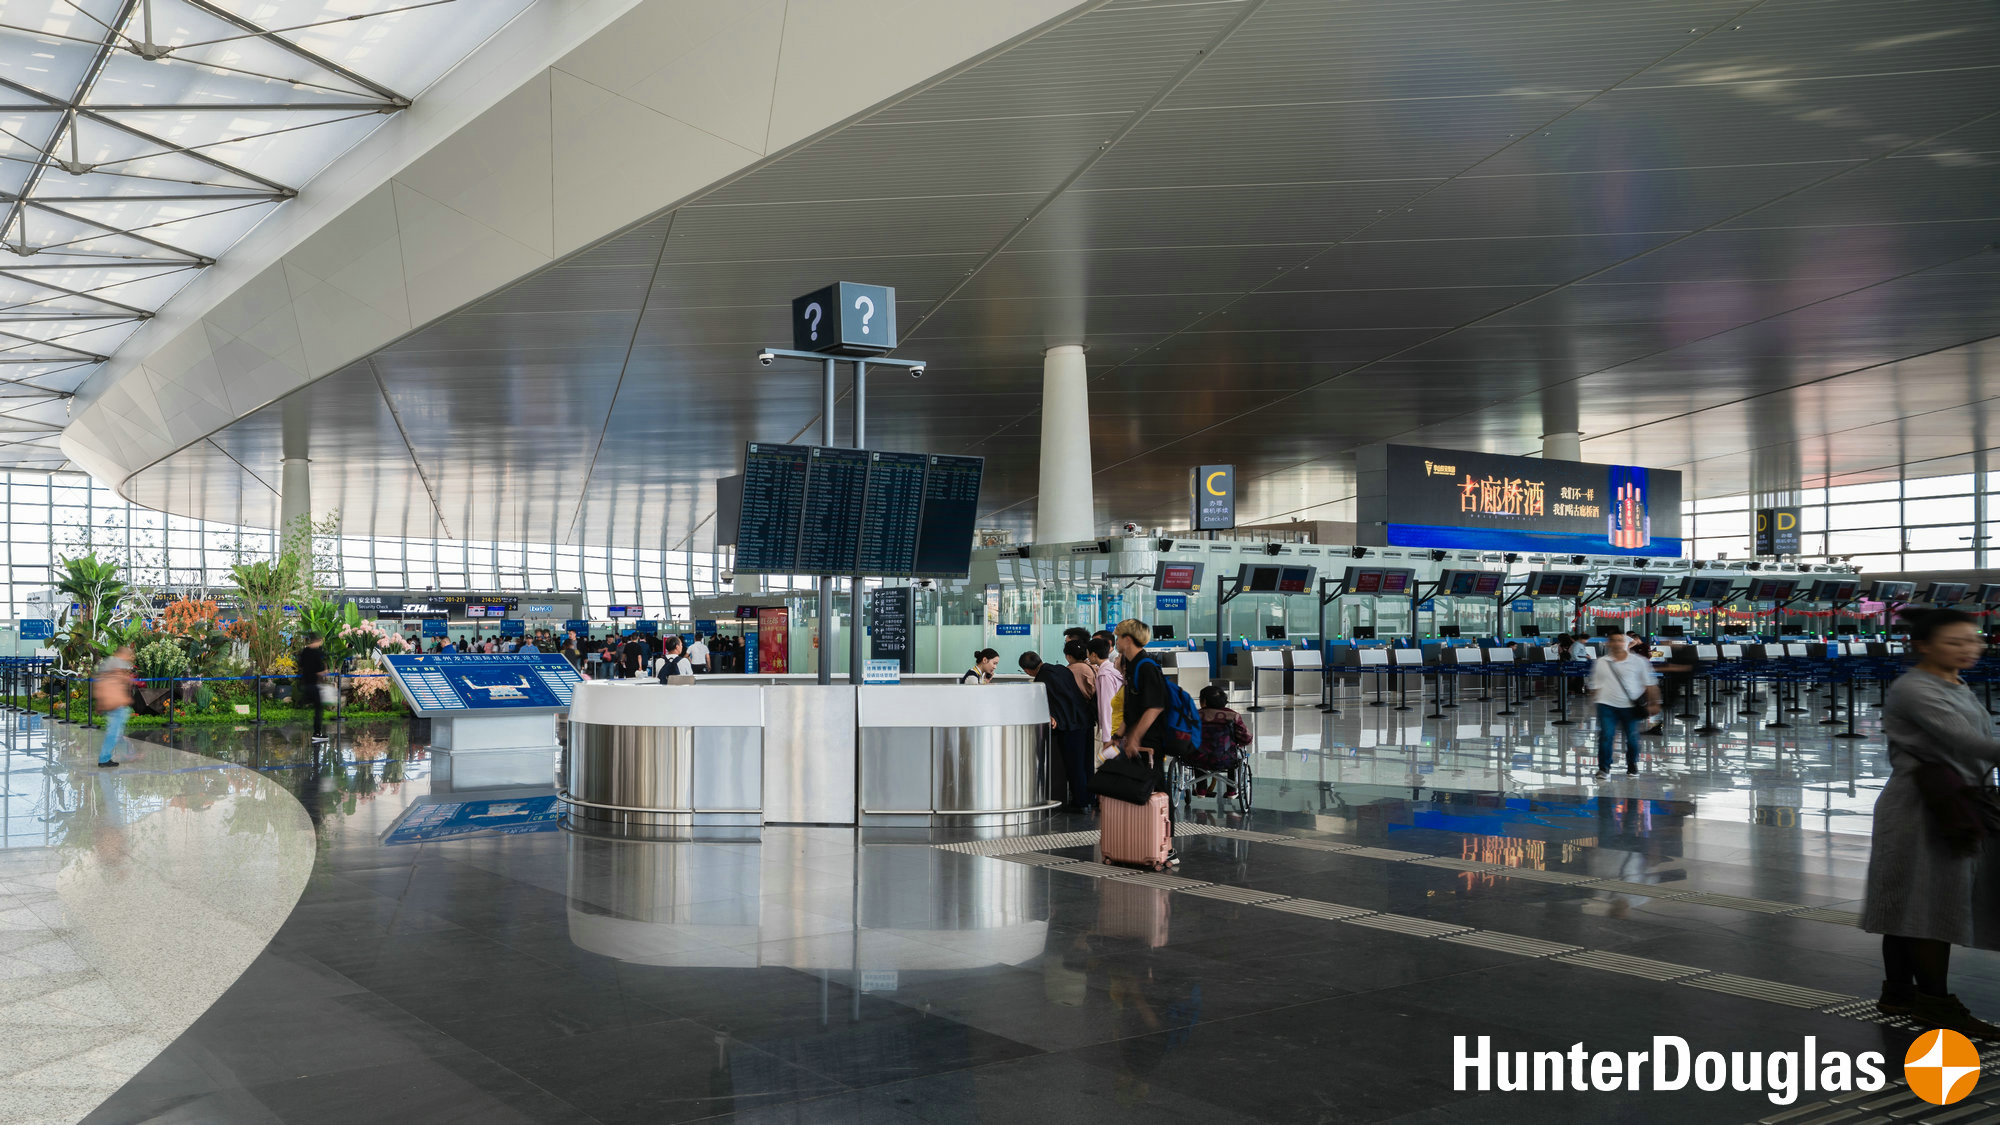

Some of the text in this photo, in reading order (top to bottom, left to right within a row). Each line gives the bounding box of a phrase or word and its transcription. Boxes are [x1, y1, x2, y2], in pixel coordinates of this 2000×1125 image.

[1206, 471, 1226, 496] C
[1457, 474, 1545, 517] 古廊桥酒
[1560, 486, 1594, 501] 我们不一样
[1552, 503, 1600, 518] 我们喝古廊桥酒
[1757, 514, 1767, 532] D
[1777, 512, 1796, 530] D
[359, 596, 382, 604] 安全检查
